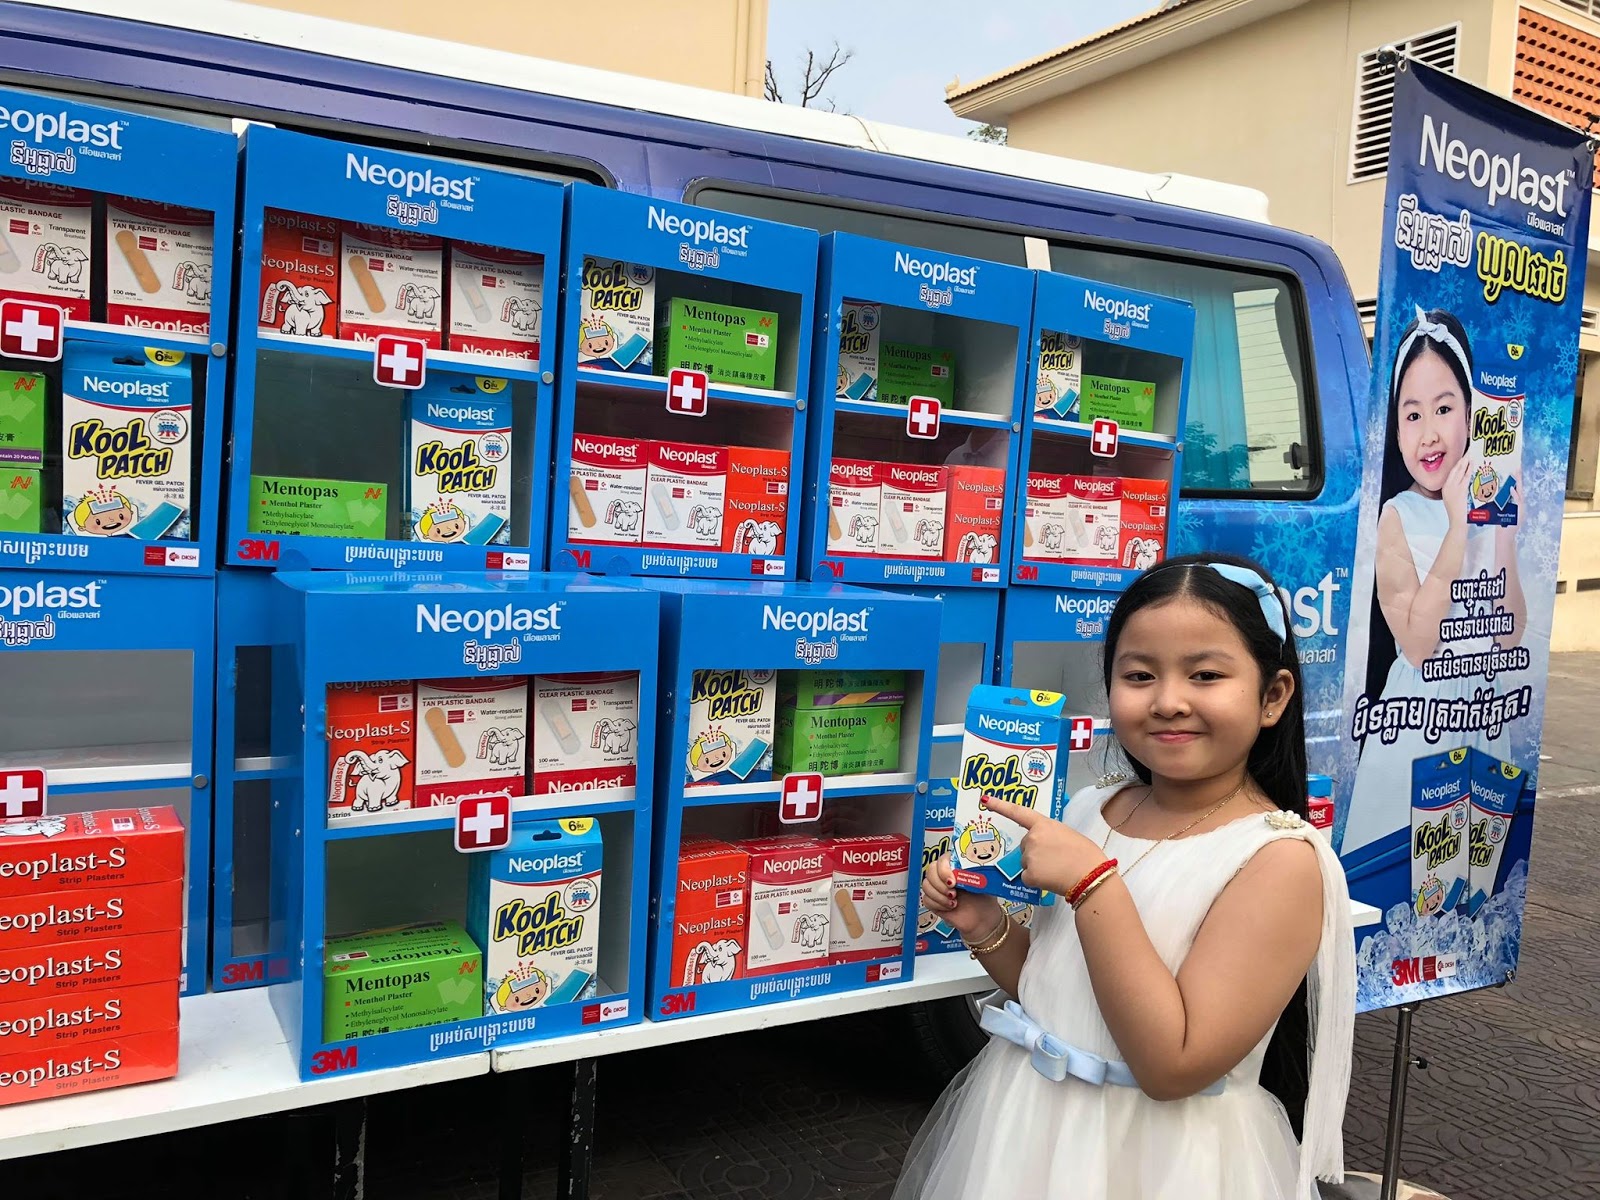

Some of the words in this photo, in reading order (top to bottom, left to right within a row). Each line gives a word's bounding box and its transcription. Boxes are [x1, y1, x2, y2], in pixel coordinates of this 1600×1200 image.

[0, 204, 26, 215] LASTIC
[28, 209, 62, 220] BANDAGE
[49, 223, 86, 235] Transparent
[359, 249, 384, 258] PLASTIC
[385, 252, 413, 262] BANDAGE
[399, 264, 438, 275] Water-resistant
[455, 262, 472, 270] CLEAR
[473, 265, 496, 274] PLASTIC
[497, 268, 523, 277] BANDAGE
[512, 280, 540, 289] Transparent
[591, 288, 642, 309] PATCH
[683, 304, 746, 327] Mentopas
[689, 325, 712, 335] Menthol
[713, 328, 732, 337] Plaster
[884, 344, 932, 362] Mentopas
[1042, 353, 1073, 369] PATCH
[1090, 380, 1130, 395] Mentopas
[1484, 431, 1515, 455] PATCH
[99, 450, 171, 477] PATCH
[731, 463, 788, 478] Neoplast-S
[439, 466, 496, 491] PATCH
[261, 480, 339, 500] Mentopas
[957, 480, 1003, 495] Neoplast-S
[1122, 490, 1166, 503] Neoplast-S
[269, 500, 298, 508] Menthol
[299, 501, 322, 510] Plaster
[729, 499, 785, 514] Neoplast-S
[954, 513, 1001, 526] Neoplast-S
[1120, 520, 1164, 532] Neoplast-S
[237, 538, 280, 561] 3M
[1016, 565, 1038, 581] 3M
[1055, 594, 1116, 618] Neoplas
[559, 690, 585, 698] PLASTIC
[585, 688, 614, 696] BANDAGE
[1036, 692, 1043, 702] 6
[422, 699, 436, 707] TAN
[437, 698, 464, 706] PLASTIC
[465, 697, 496, 705] BANDAGE
[603, 699, 634, 707] Transparent
[709, 690, 763, 718] PATCH
[480, 707, 523, 716] Water-resistant
[811, 715, 867, 729] Mentopas
[816, 732, 837, 740] Menthol
[837, 732, 855, 740] Plaster
[1421, 780, 1462, 801] Neoplast
[567, 820, 576, 832] 6
[1428, 833, 1461, 868] PATCH
[0, 847, 126, 880] eoplast-S
[58, 876, 82, 885] Strip
[86, 873, 125, 882] Plasters
[680, 871, 746, 892] Neoplast-S
[1022, 886, 1038, 895] Thailand
[0, 898, 124, 933] eoplast-S
[56, 928, 80, 936] Strip
[84, 923, 123, 933] Plasters
[678, 913, 744, 935] Neoplast-S
[520, 918, 582, 954] PATCH
[0, 949, 122, 986] eoplast-S
[221, 960, 263, 985] 3M
[1391, 957, 1420, 987] 3M
[1444, 961, 1455, 969] DKSH
[55, 980, 79, 988] Strip
[82, 974, 121, 985] Plasters
[345, 969, 430, 994] Mentopas
[354, 994, 386, 1006] Menthol
[387, 990, 413, 1002] Plaster
[660, 992, 696, 1015] 3M
[0, 999, 122, 1037] eoplast-S
[350, 1004, 404, 1018] Methylsalicylate
[350, 1015, 399, 1028] Ethyleneglycol
[400, 1005, 448, 1019] Monosalicylate
[613, 1006, 627, 1014] DKSH
[55, 1031, 78, 1040] Strip
[82, 1024, 121, 1035] Plasters
[0, 1049, 121, 1087] eoplast-S
[310, 1046, 358, 1075] 3M
[55, 1081, 78, 1090] Strip
[82, 1074, 120, 1086] Plasters
